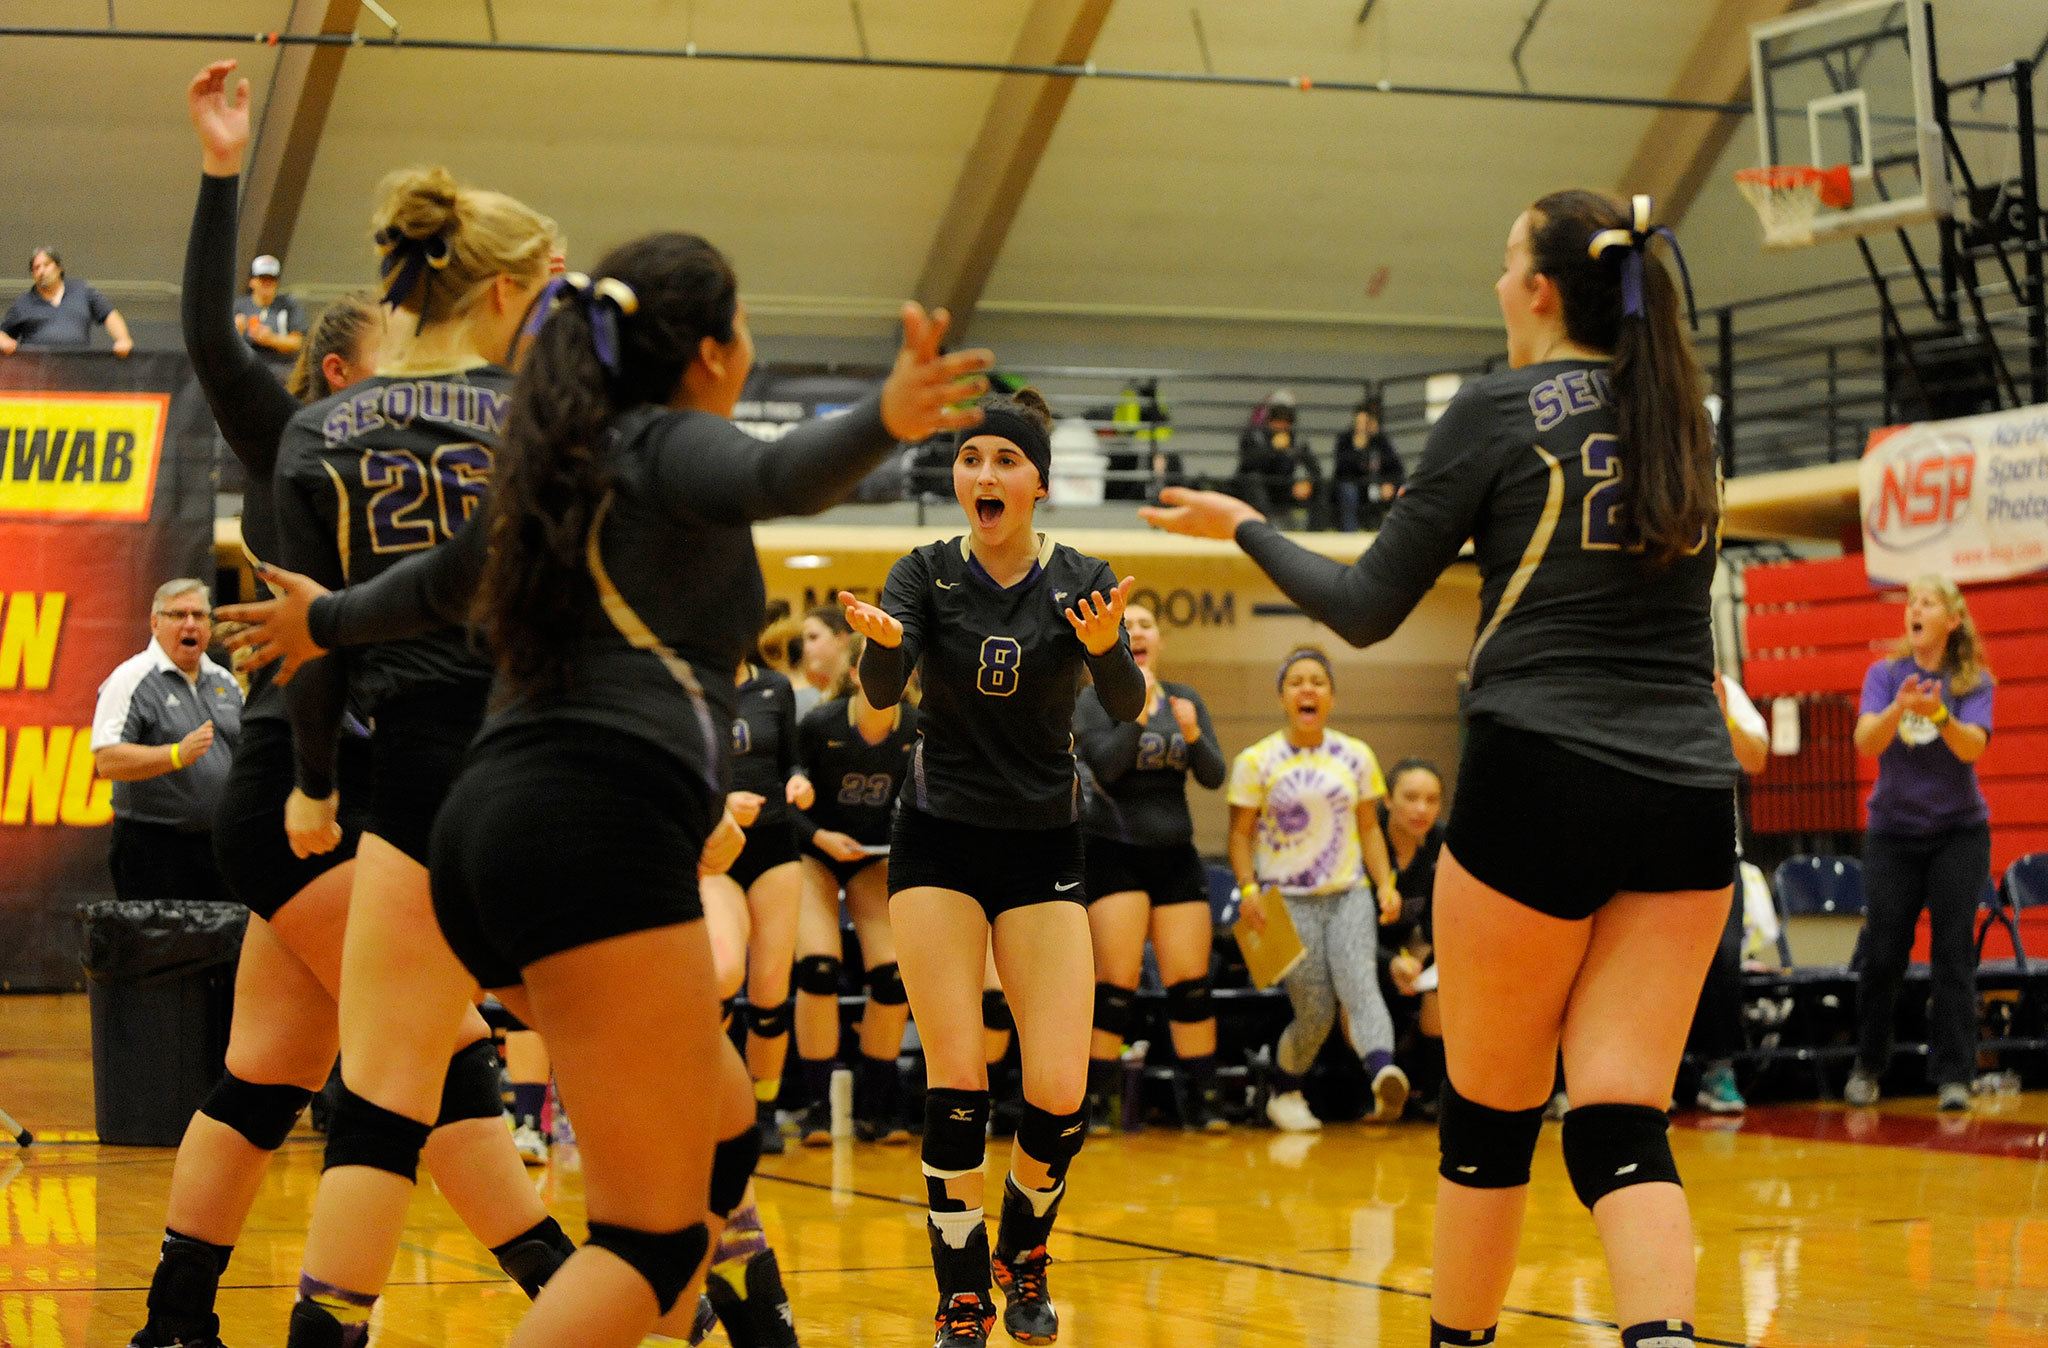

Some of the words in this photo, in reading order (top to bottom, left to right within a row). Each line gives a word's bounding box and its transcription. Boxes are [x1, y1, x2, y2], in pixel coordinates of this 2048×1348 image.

[1529, 368, 1613, 432] SE
[1878, 452, 1976, 533] NSP
[977, 636, 1021, 697] 8
